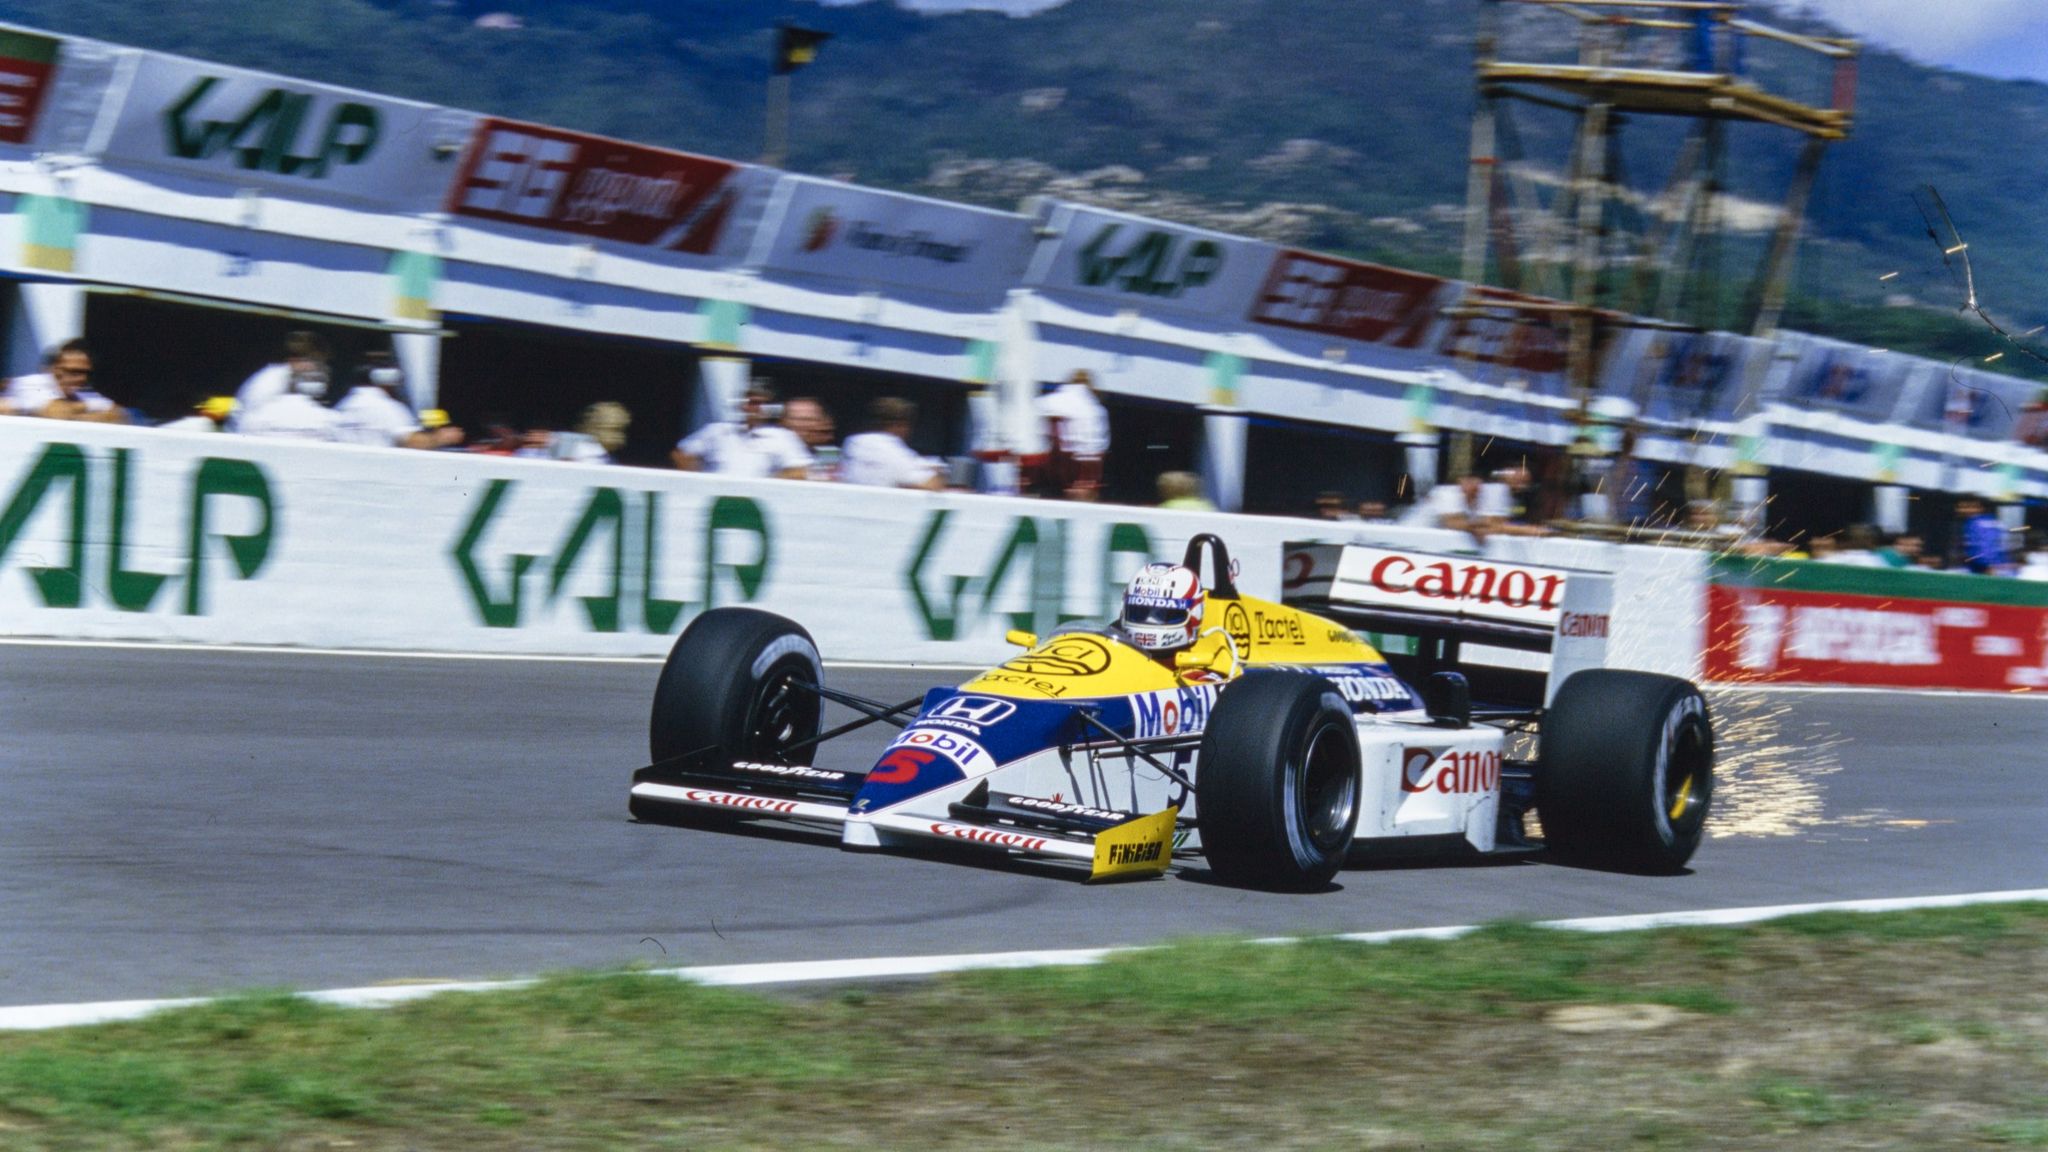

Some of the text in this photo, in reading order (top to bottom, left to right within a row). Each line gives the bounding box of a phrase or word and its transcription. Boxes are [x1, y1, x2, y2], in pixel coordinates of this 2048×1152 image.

[163, 76, 382, 180] GALP
[0, 441, 277, 616] ALP
[450, 478, 772, 635] GALP
[1127, 596, 1178, 609] HONDA
[1255, 611, 1305, 640] Tactel
[981, 674, 1068, 697] actel
[1134, 684, 1211, 738] Mobil
[915, 719, 981, 735] HONDA
[732, 761, 845, 780] GOODYEAR
[864, 748, 937, 784] 5
[1166, 748, 1193, 814] 5
[685, 790, 799, 813] Canon
[1008, 797, 1126, 821] GOODYEAR
[930, 823, 1047, 850] Canon
